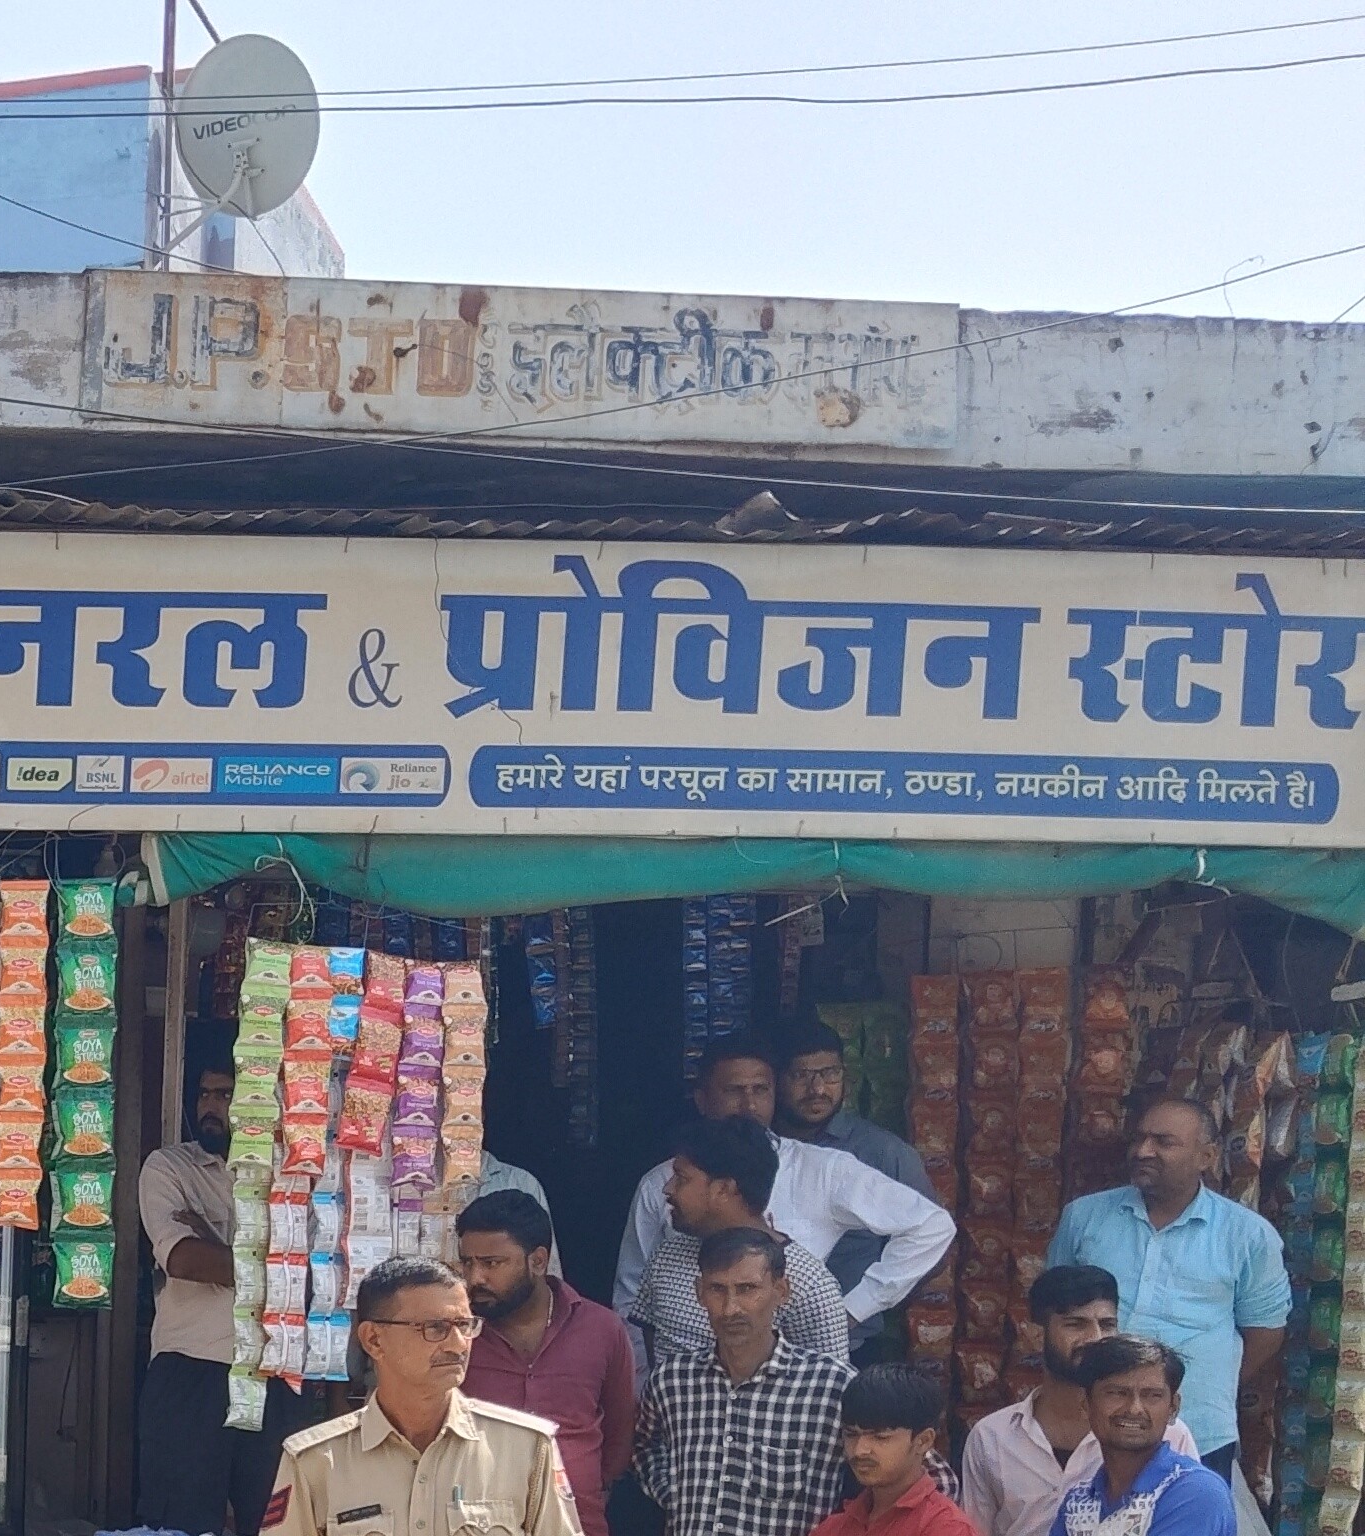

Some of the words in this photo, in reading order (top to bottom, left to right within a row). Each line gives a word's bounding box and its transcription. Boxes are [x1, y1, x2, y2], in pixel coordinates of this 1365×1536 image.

[347, 628, 403, 709] &
[439, 555, 1041, 720] प्रोविजन
[1068, 573, 1365, 731] स्टोर
[171, 770, 209, 787] airtel
[390, 763, 437, 775] Reliance
[495, 753, 566, 793] हमारे
[573, 755, 632, 793] यहां
[638, 766, 729, 801] परचून
[736, 767, 779, 793] का
[994, 763, 1109, 800] नमकीन
[1116, 766, 1189, 804] आदि
[1197, 768, 1280, 805] मिलते
